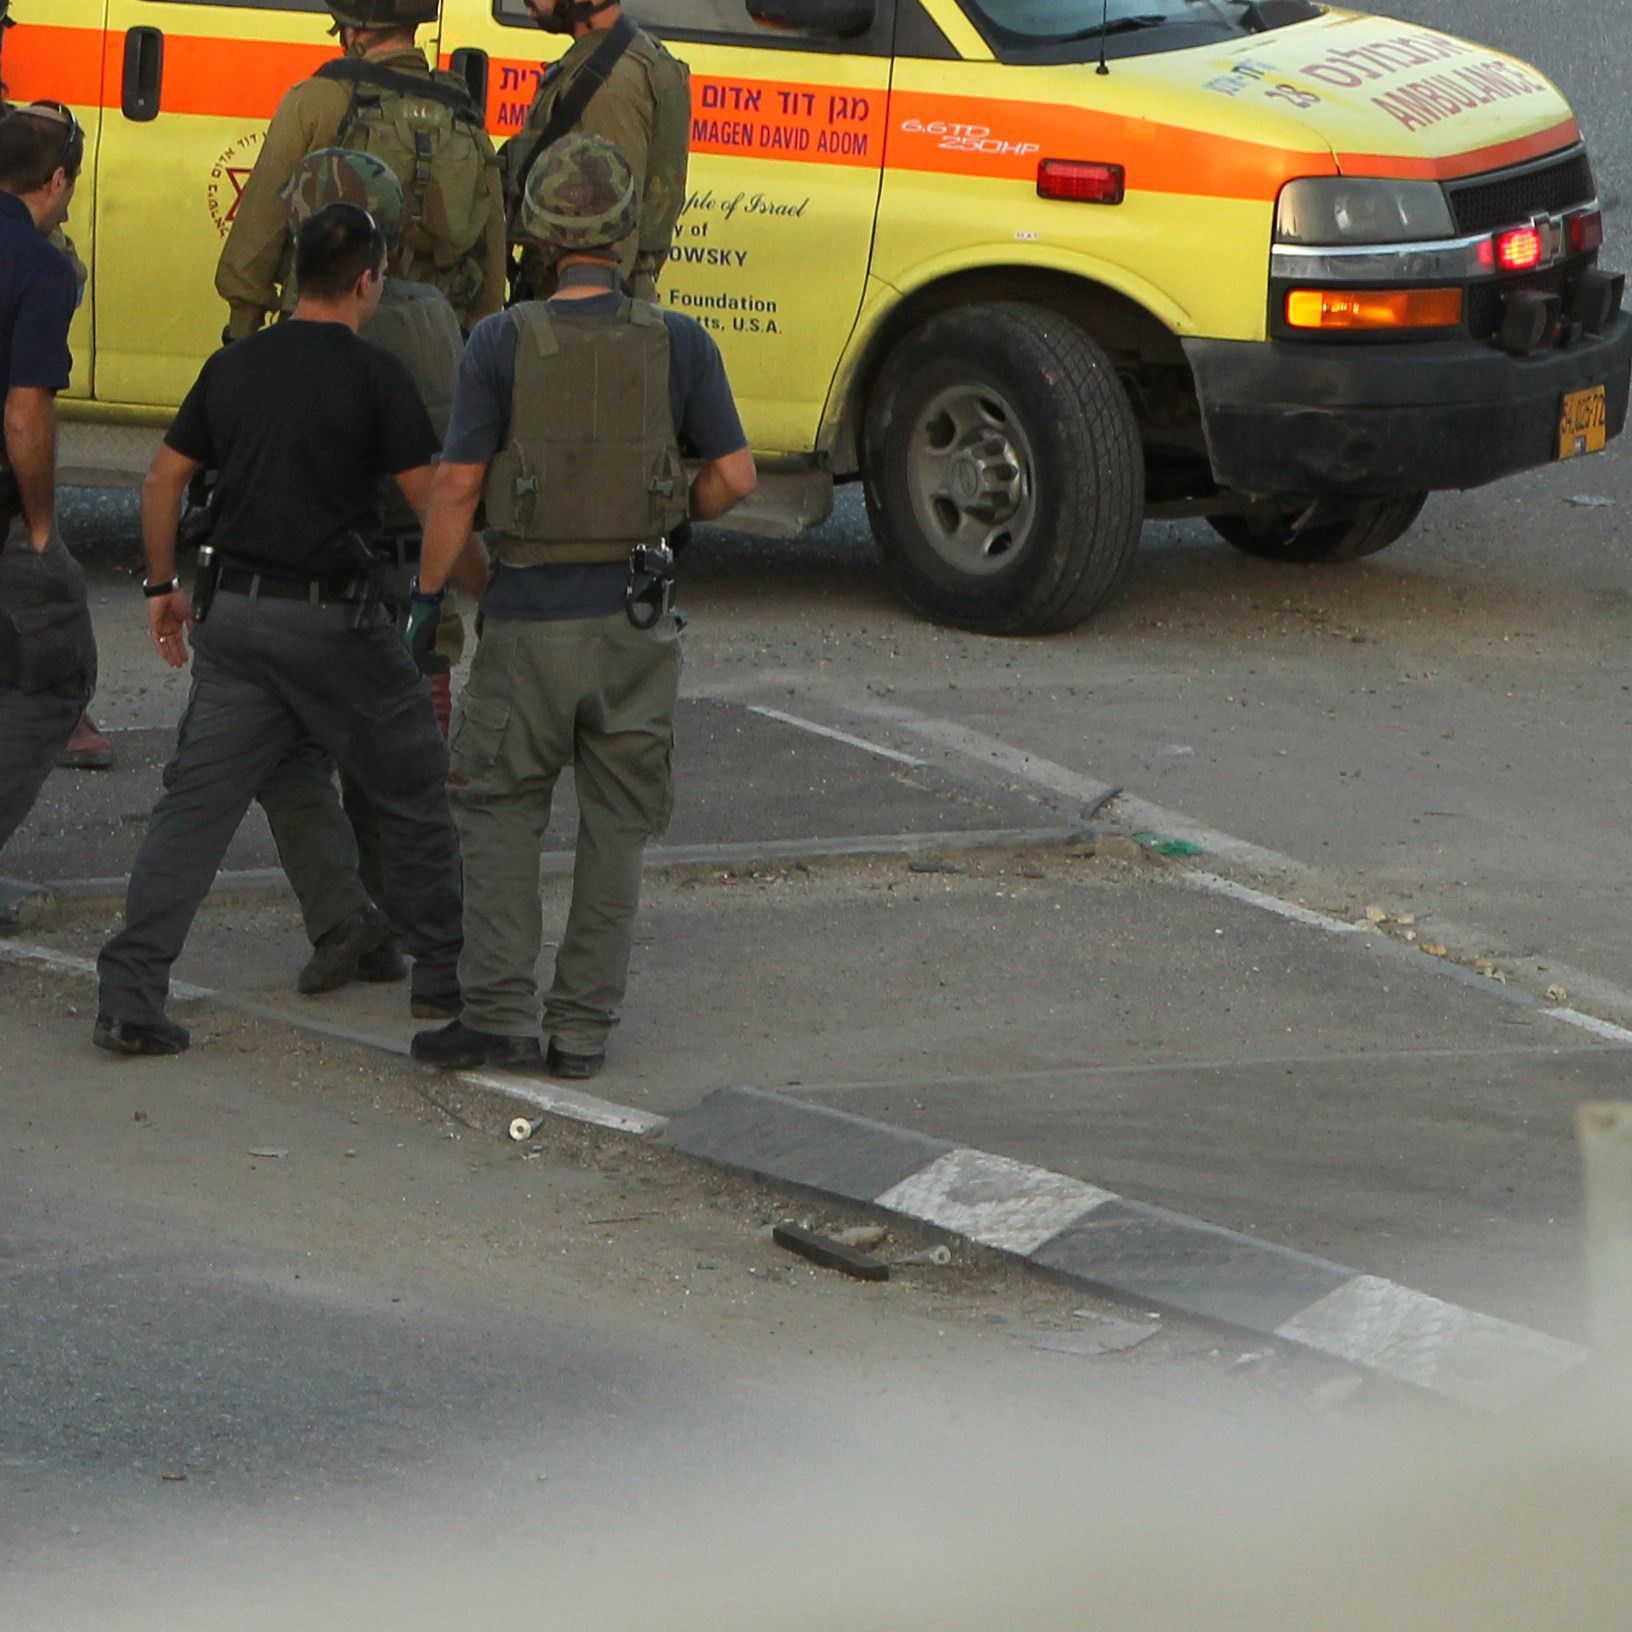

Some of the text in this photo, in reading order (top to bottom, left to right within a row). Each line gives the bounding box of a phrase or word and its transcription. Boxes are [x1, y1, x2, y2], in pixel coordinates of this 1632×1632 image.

[701, 83, 870, 125] מגן דוד אדום
[1370, 60, 1547, 134] AMBULANCE
[691, 118, 868, 157] MAGEN DAVID ADOM
[938, 135, 1040, 156] 250HP
[720, 192, 740, 220] of
[744, 192, 811, 220] Israel
[691, 222, 709, 238] of
[668, 245, 748, 268] OWSKY
[669, 289, 778, 314] Foundation
[733, 316, 783, 334] U.S.A.
